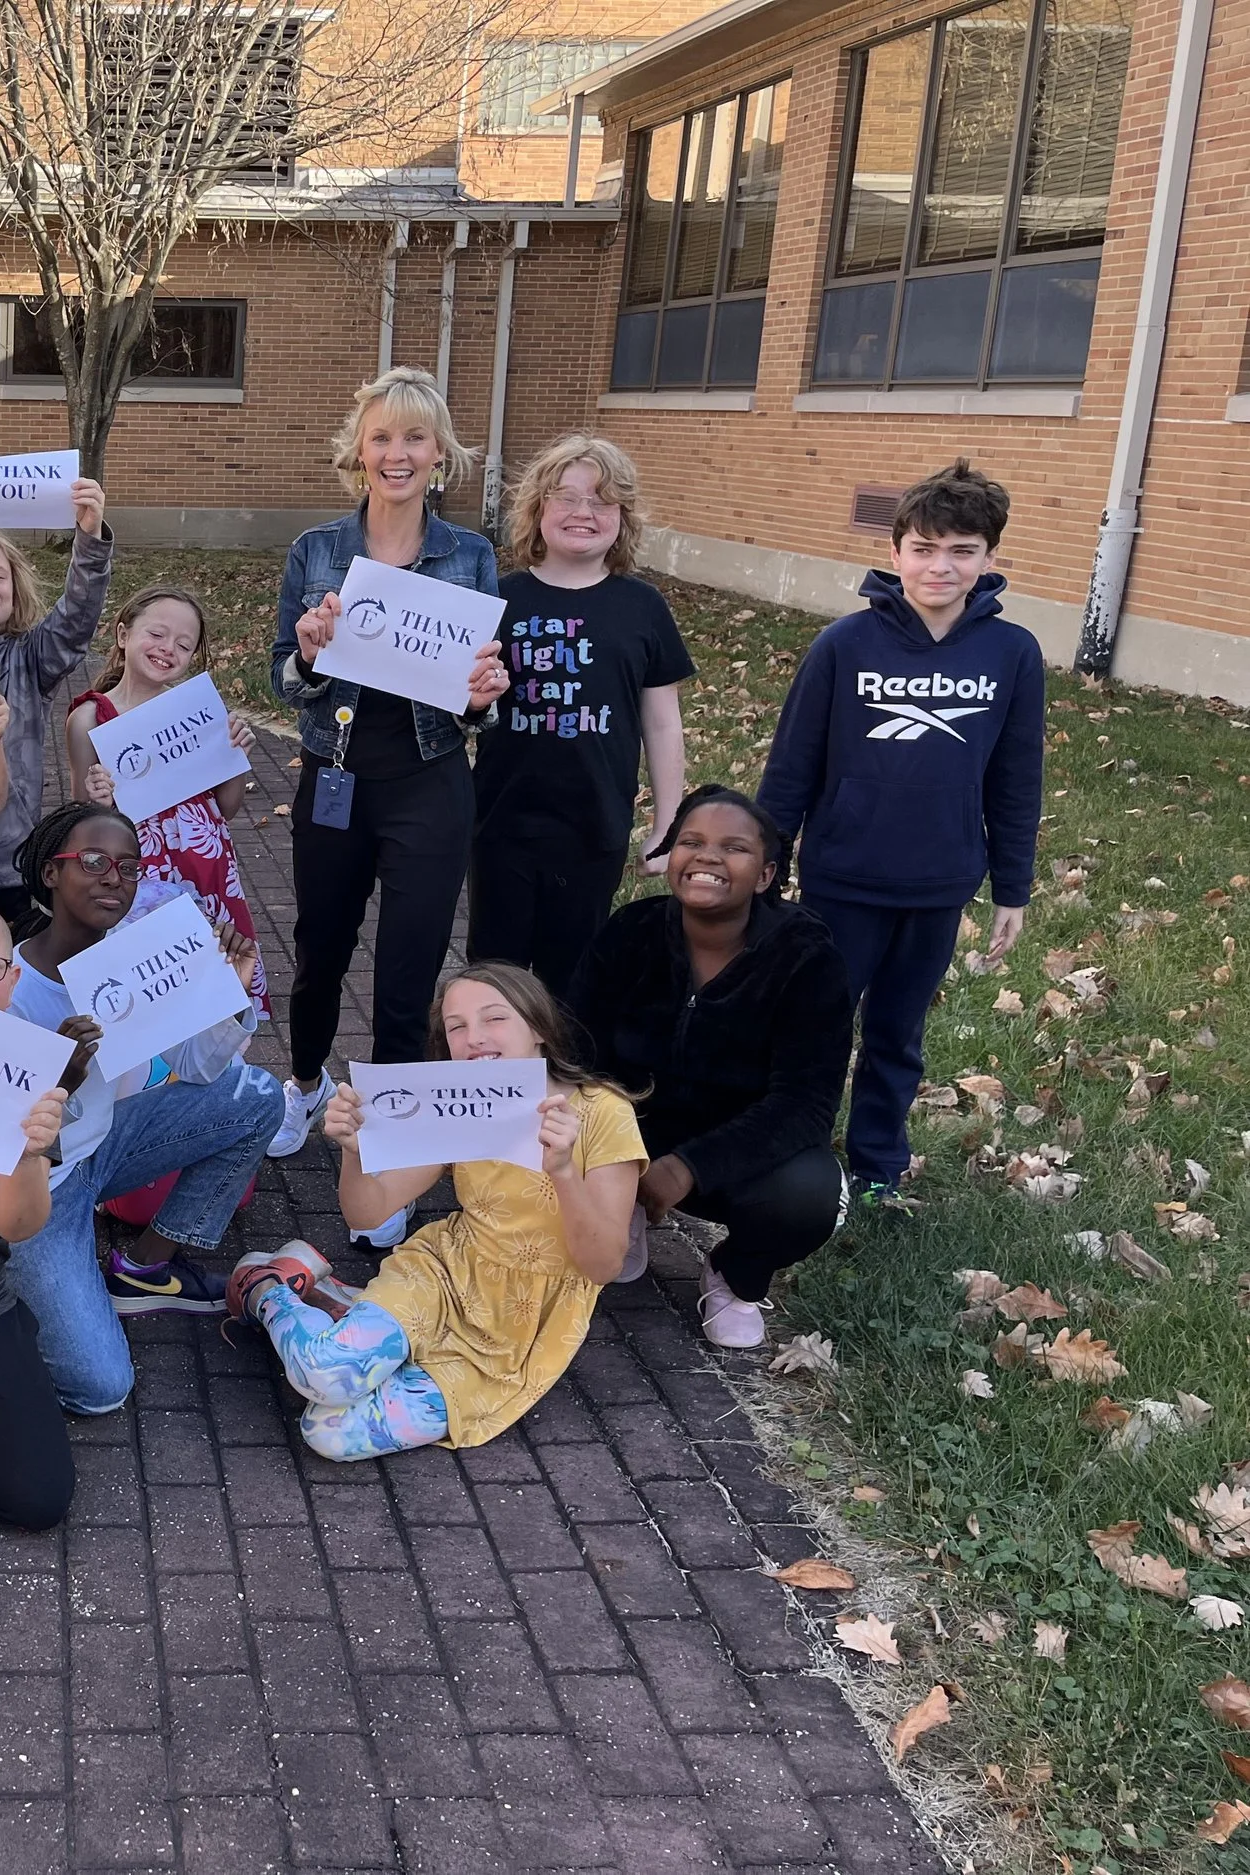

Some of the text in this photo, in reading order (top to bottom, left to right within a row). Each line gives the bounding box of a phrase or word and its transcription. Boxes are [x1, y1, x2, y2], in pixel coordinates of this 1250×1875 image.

[358, 609, 378, 629] F
[400, 609, 476, 647] THANK
[512, 616, 584, 638] star
[392, 631, 443, 660] YOU!
[511, 638, 594, 674] light
[514, 678, 582, 705] star
[857, 671, 998, 701] Reebok
[151, 707, 214, 747] THANK
[511, 705, 611, 739] bright
[128, 753, 140, 772] F
[158, 734, 201, 764] YOU!
[131, 931, 204, 981] THANK
[141, 965, 189, 1003] YOU!
[105, 990, 120, 1014] F
[389, 1096, 406, 1110] F
[430, 1085, 524, 1099] THANK
[432, 1102, 493, 1118] YOU!
